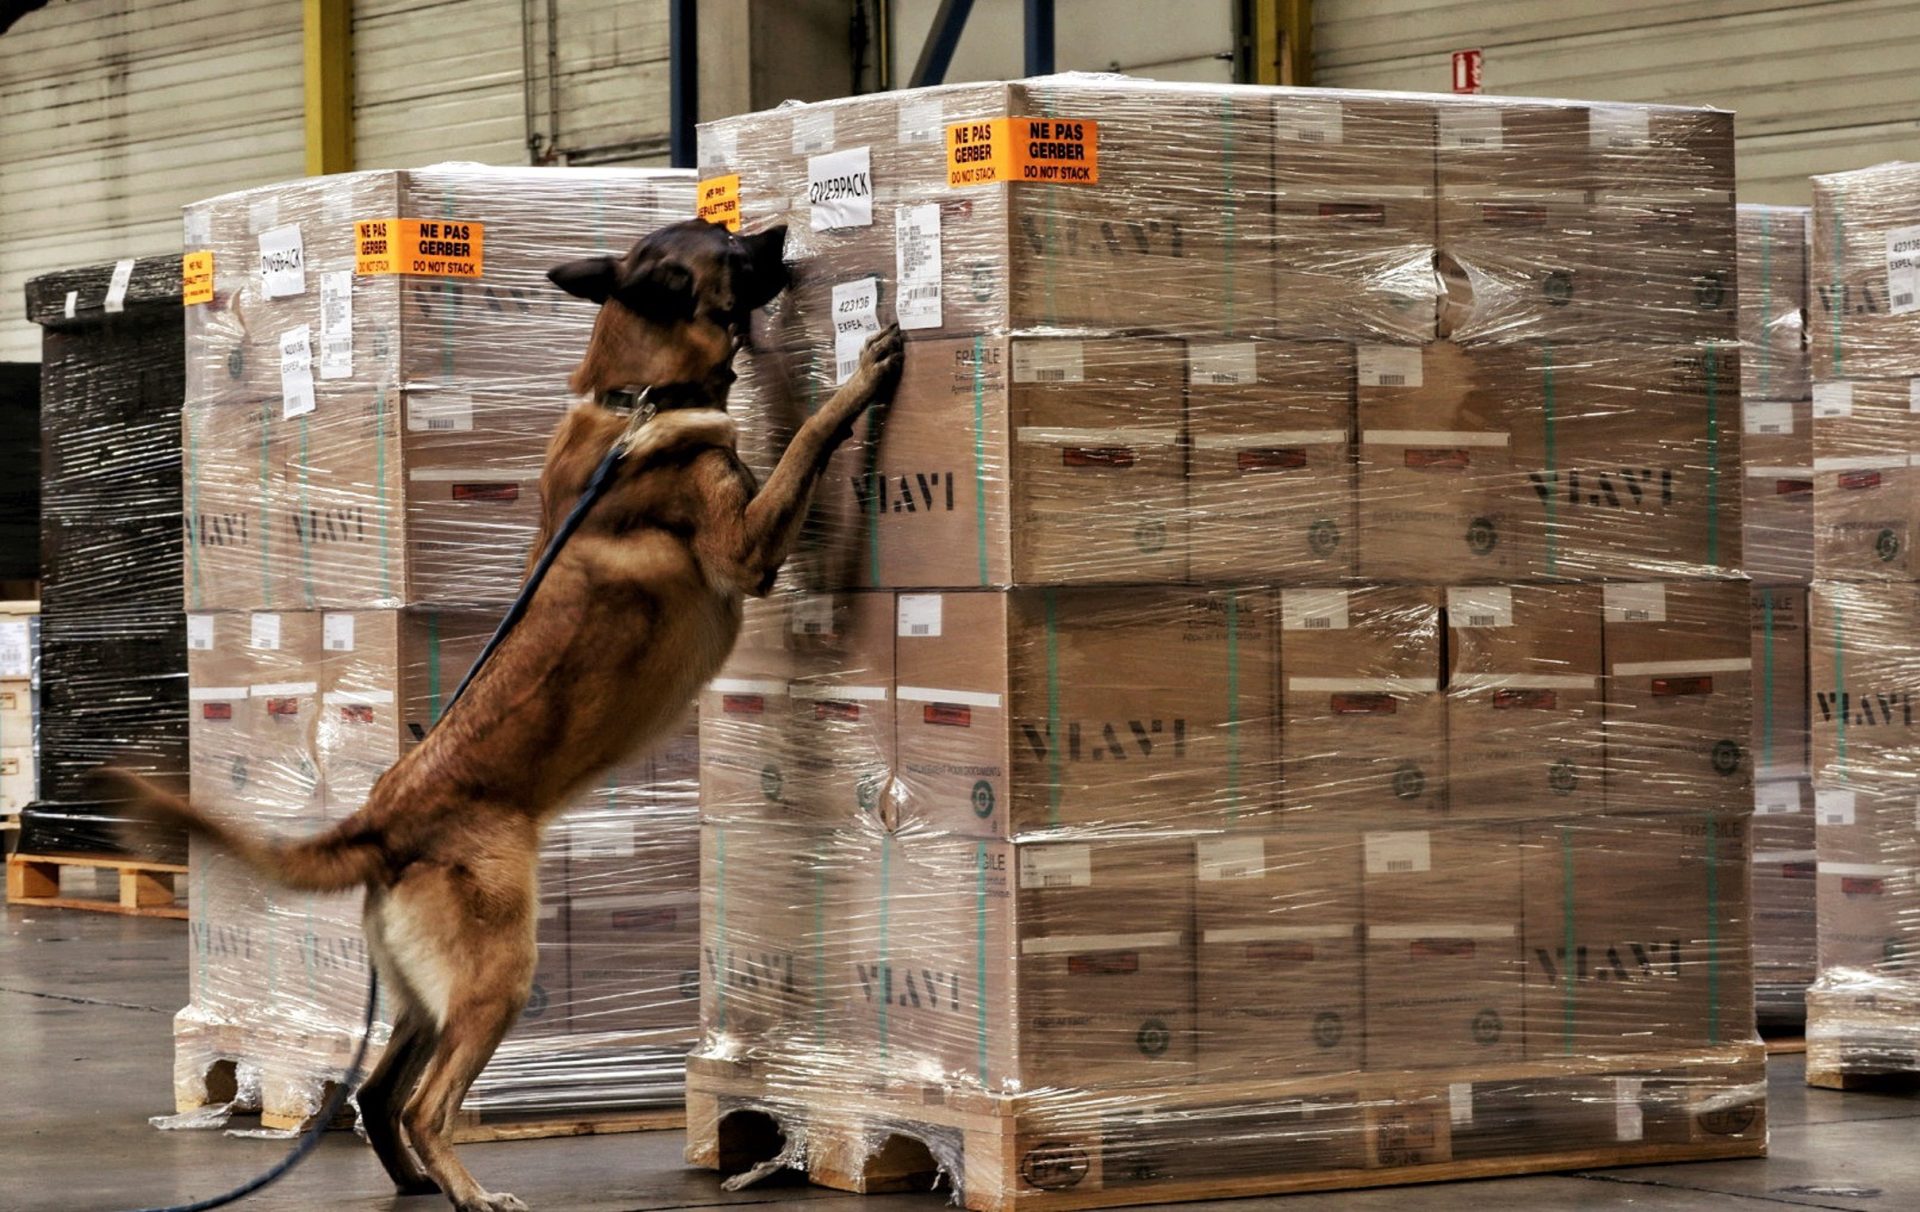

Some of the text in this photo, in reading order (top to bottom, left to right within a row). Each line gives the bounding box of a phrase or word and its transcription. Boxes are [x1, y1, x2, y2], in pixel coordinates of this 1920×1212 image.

[955, 124, 991, 144] NE PAS
[1030, 123, 1083, 141] NE PAS
[955, 144, 992, 164] GERBER
[1029, 142, 1084, 160] GERBER
[952, 167, 995, 184] DO NOT STACK
[1024, 165, 1090, 180] DO NOT STACK
[810, 172, 868, 204] OVERPACK
[360, 223, 387, 238] NE PAS
[420, 223, 470, 240] NE PAS
[362, 240, 387, 255] GERBER
[419, 241, 470, 257] GERBER
[413, 260, 475, 274] DO NOT STACK
[851, 472, 953, 514] VIAVI
[1529, 468, 1672, 507] VIAVI
[293, 507, 363, 543] VIAVI
[1817, 692, 1911, 727] VIAVI
[1020, 719, 1184, 762] VIAVI
[1535, 940, 1680, 986] VIAVI
[857, 964, 960, 1012] VIAVI
